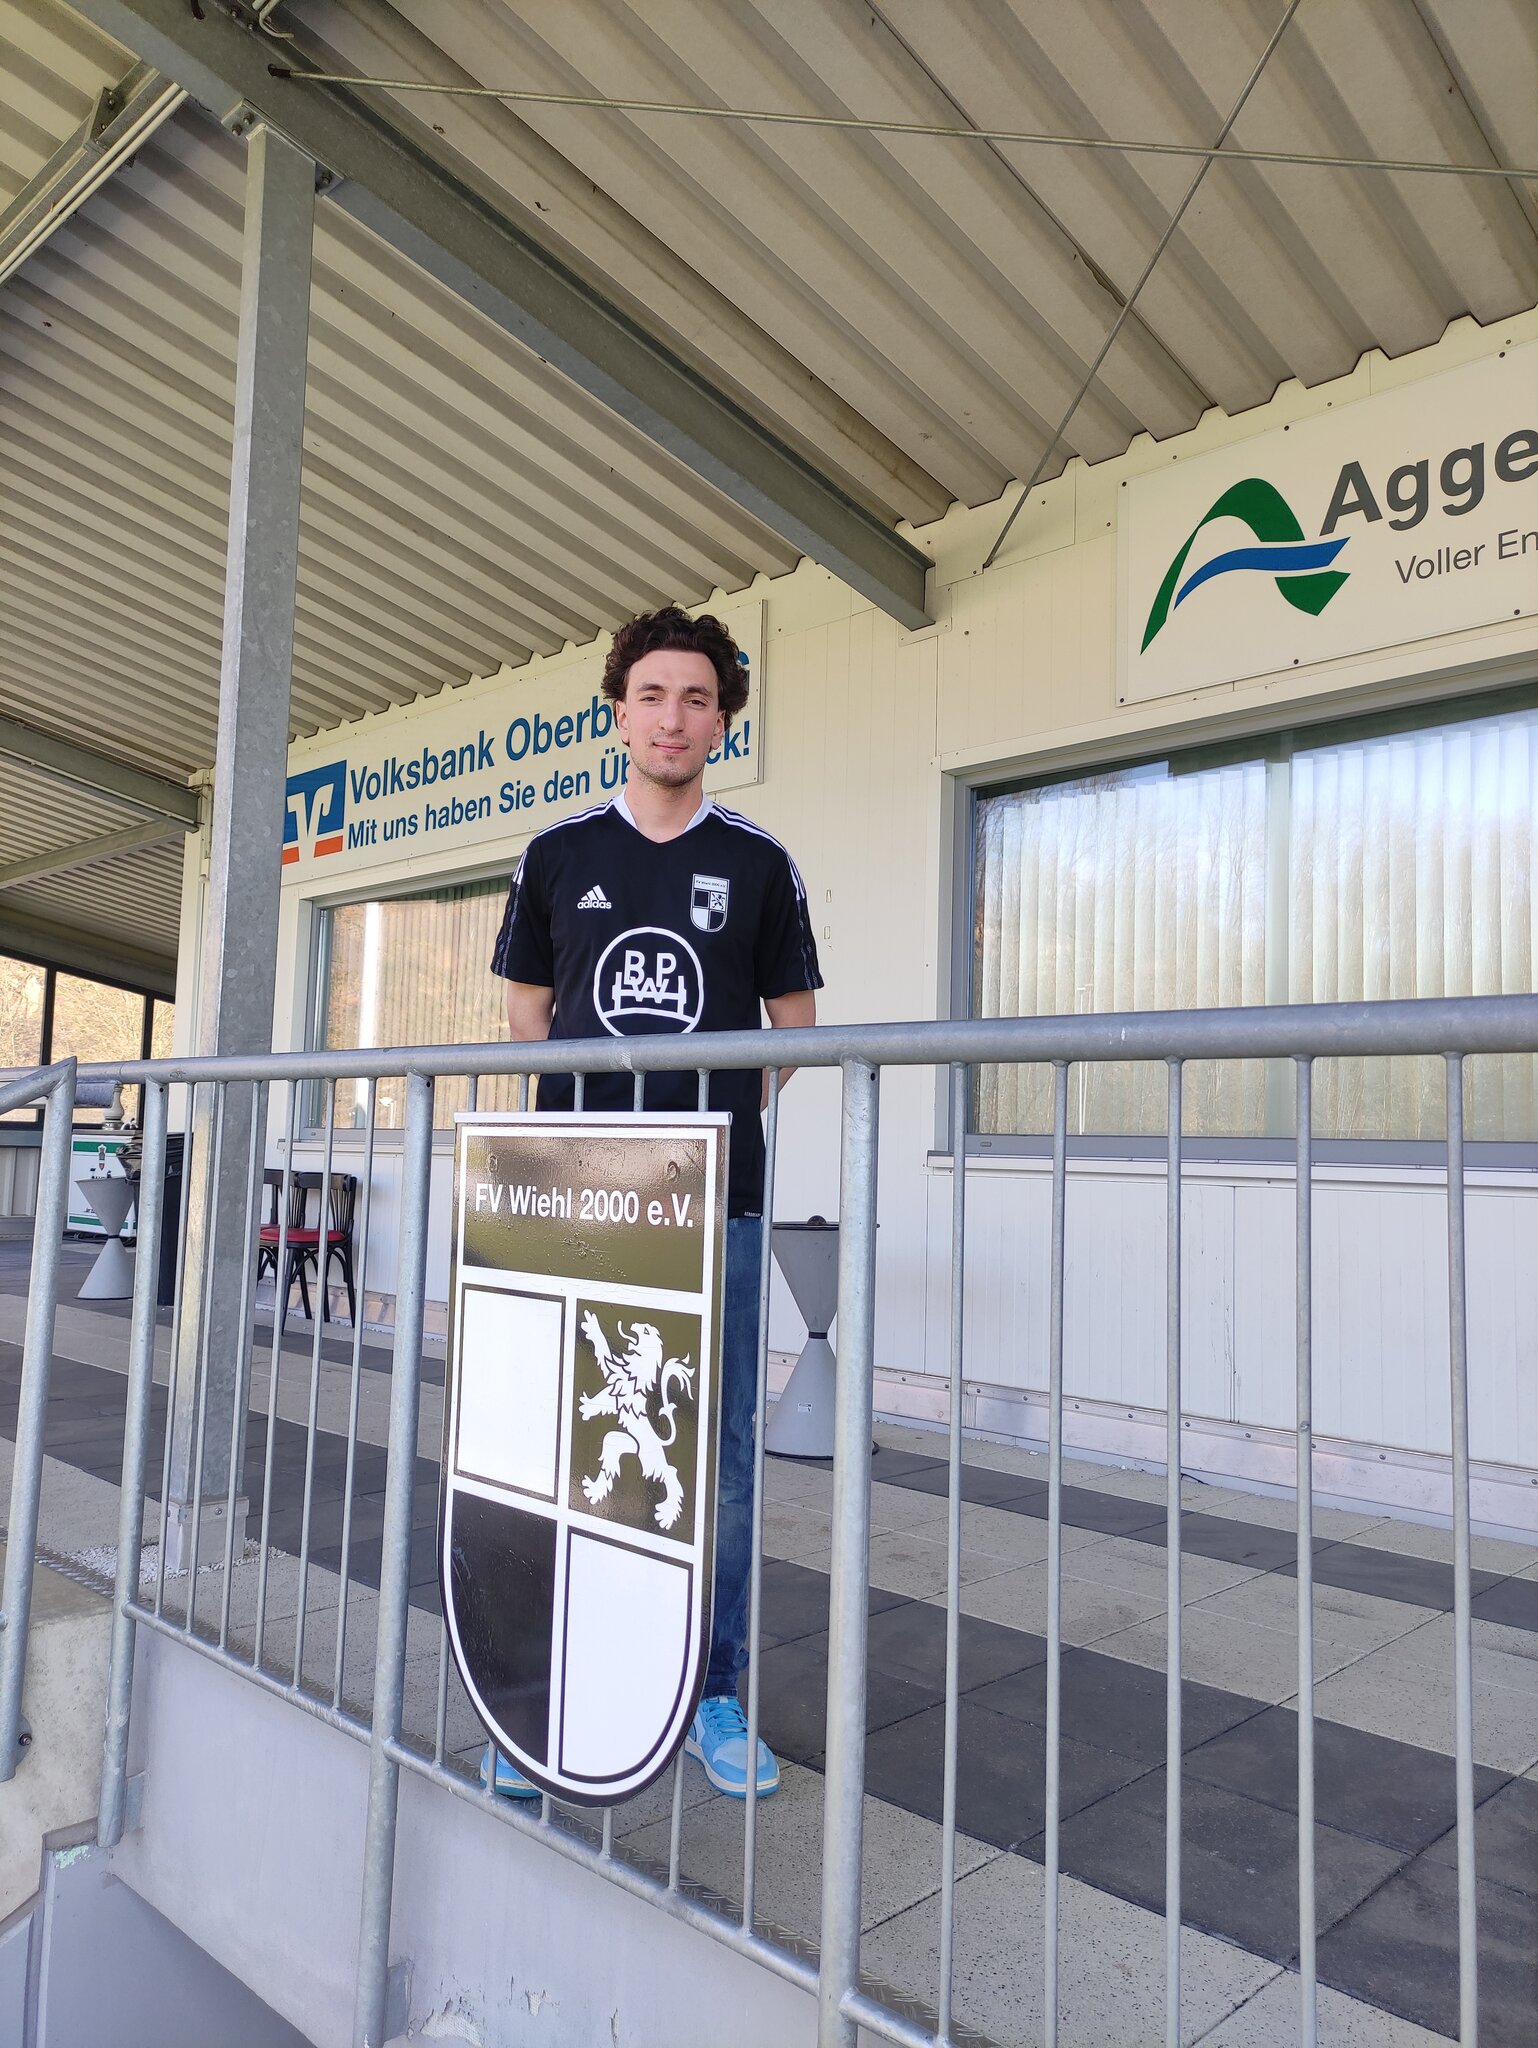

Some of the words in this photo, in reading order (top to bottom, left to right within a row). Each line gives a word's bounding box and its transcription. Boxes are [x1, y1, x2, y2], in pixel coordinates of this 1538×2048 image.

[1319, 428, 1538, 537] Agge
[1394, 543, 1486, 584] Voller
[350, 729, 495, 805] Volksbank
[505, 695, 617, 762] Oberb
[347, 818, 377, 850] Mit
[383, 814, 419, 842] uns
[425, 795, 492, 833] haben
[498, 780, 536, 815] Sie
[543, 769, 591, 804] den
[577, 899, 612, 910] adidas
[475, 1183, 503, 1213] FV
[508, 1184, 572, 1219] Wiehl
[579, 1188, 639, 1224] 2000
[647, 1193, 694, 1228] e.V.
